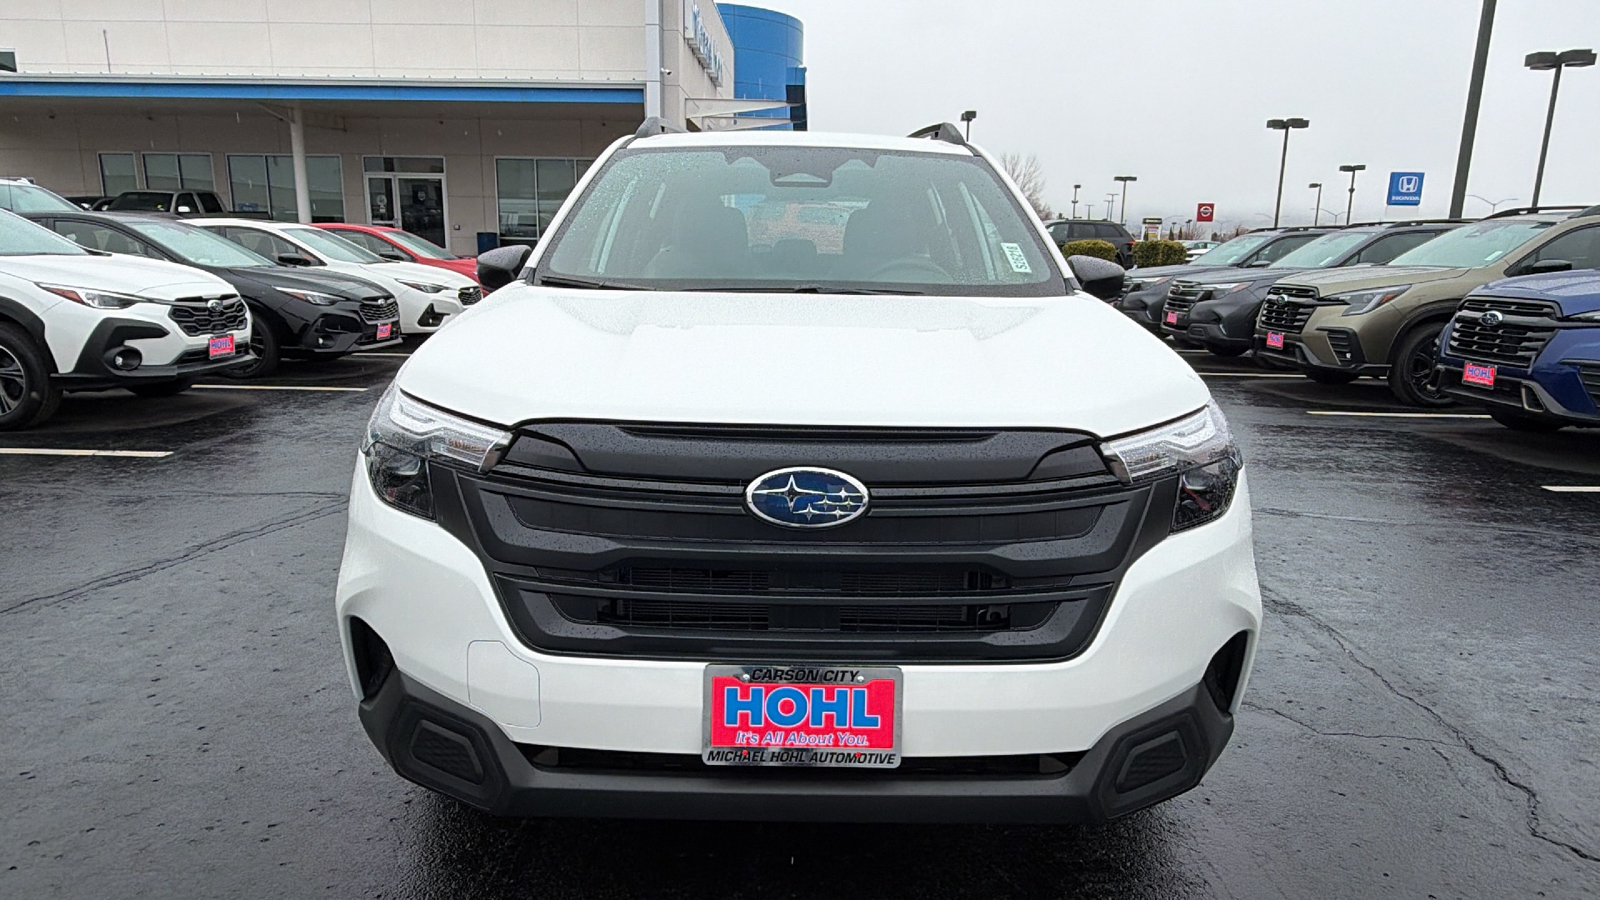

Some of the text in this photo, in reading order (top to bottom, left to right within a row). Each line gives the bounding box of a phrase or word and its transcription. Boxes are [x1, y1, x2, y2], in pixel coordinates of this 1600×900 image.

[1468, 367, 1491, 378] HOHL
[751, 668, 860, 682] CARSON CITY
[724, 686, 881, 729] HOHL
[735, 731, 870, 746] It's All About You.
[707, 750, 896, 765] MICHAEL HOHL AUTOMOTIVE
